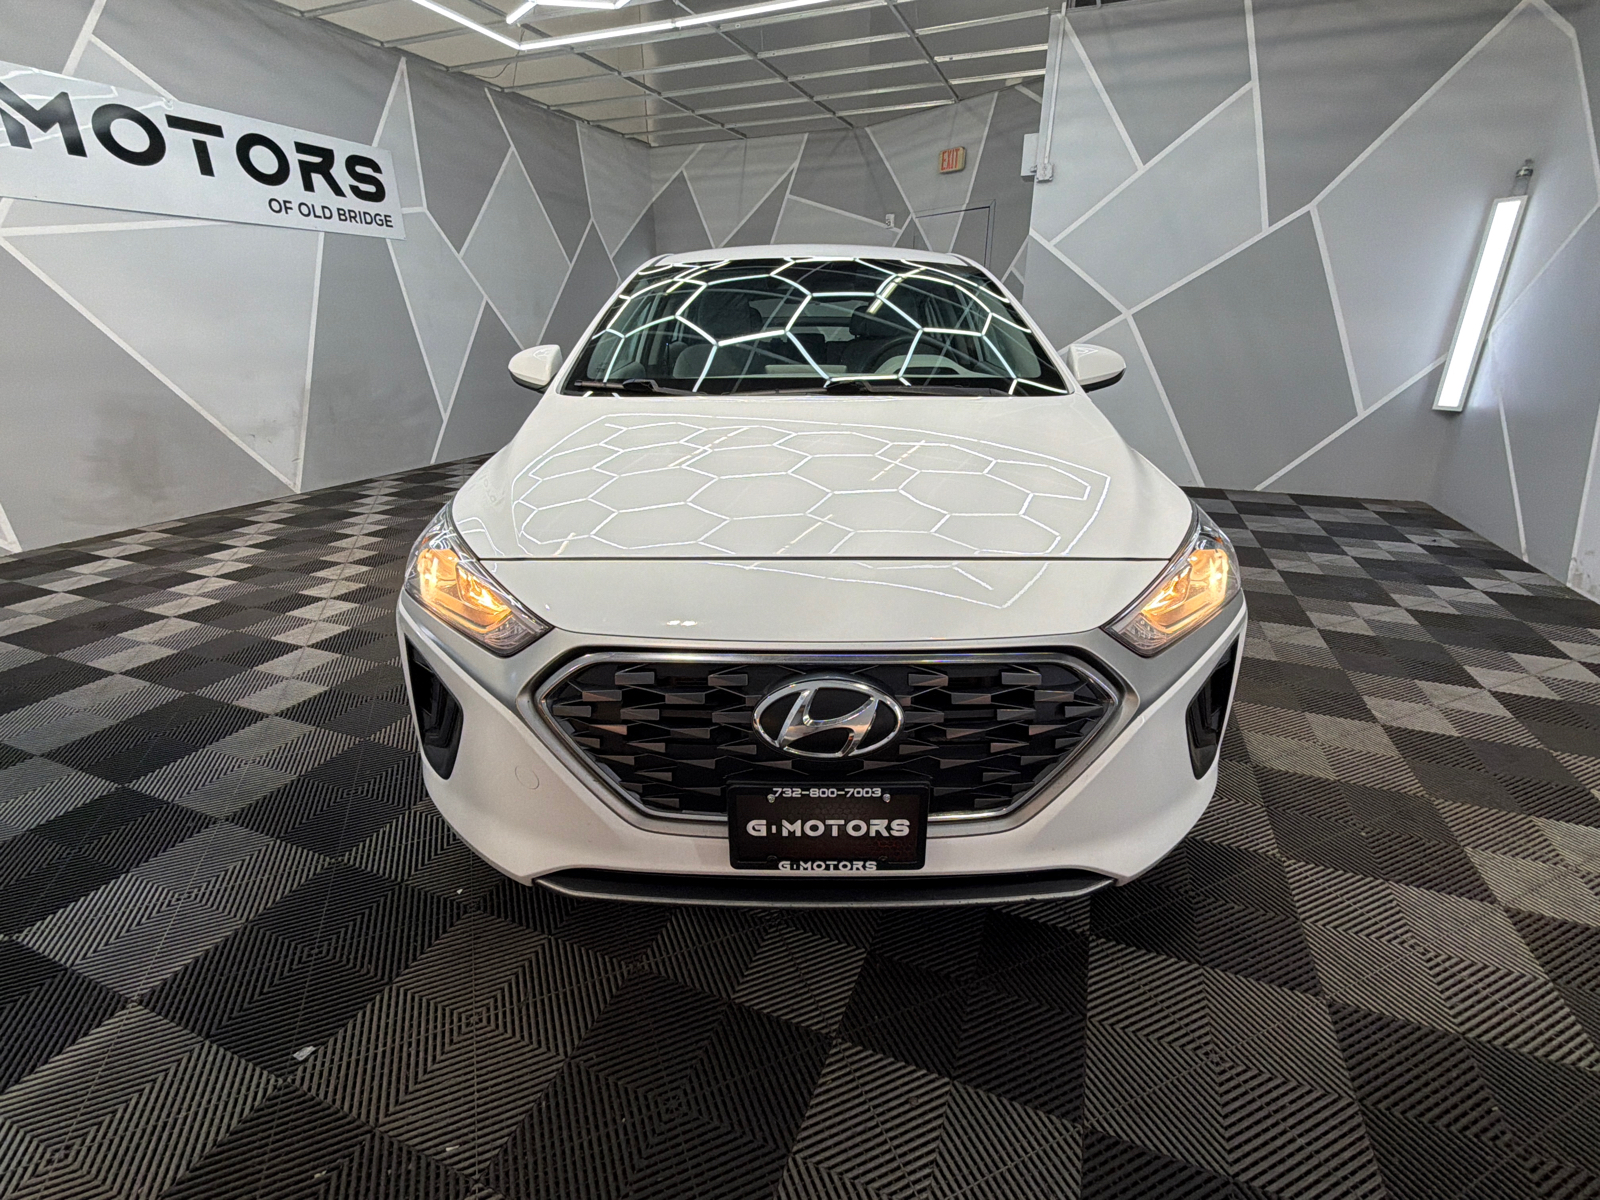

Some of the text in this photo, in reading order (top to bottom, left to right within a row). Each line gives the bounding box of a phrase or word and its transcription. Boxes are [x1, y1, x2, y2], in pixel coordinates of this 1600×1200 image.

[0, 80, 387, 203] MOTORS
[941, 148, 960, 171] EXIT
[268, 198, 394, 228] OF OLD BRIDGE
[772, 787, 882, 798] 732-800-7003
